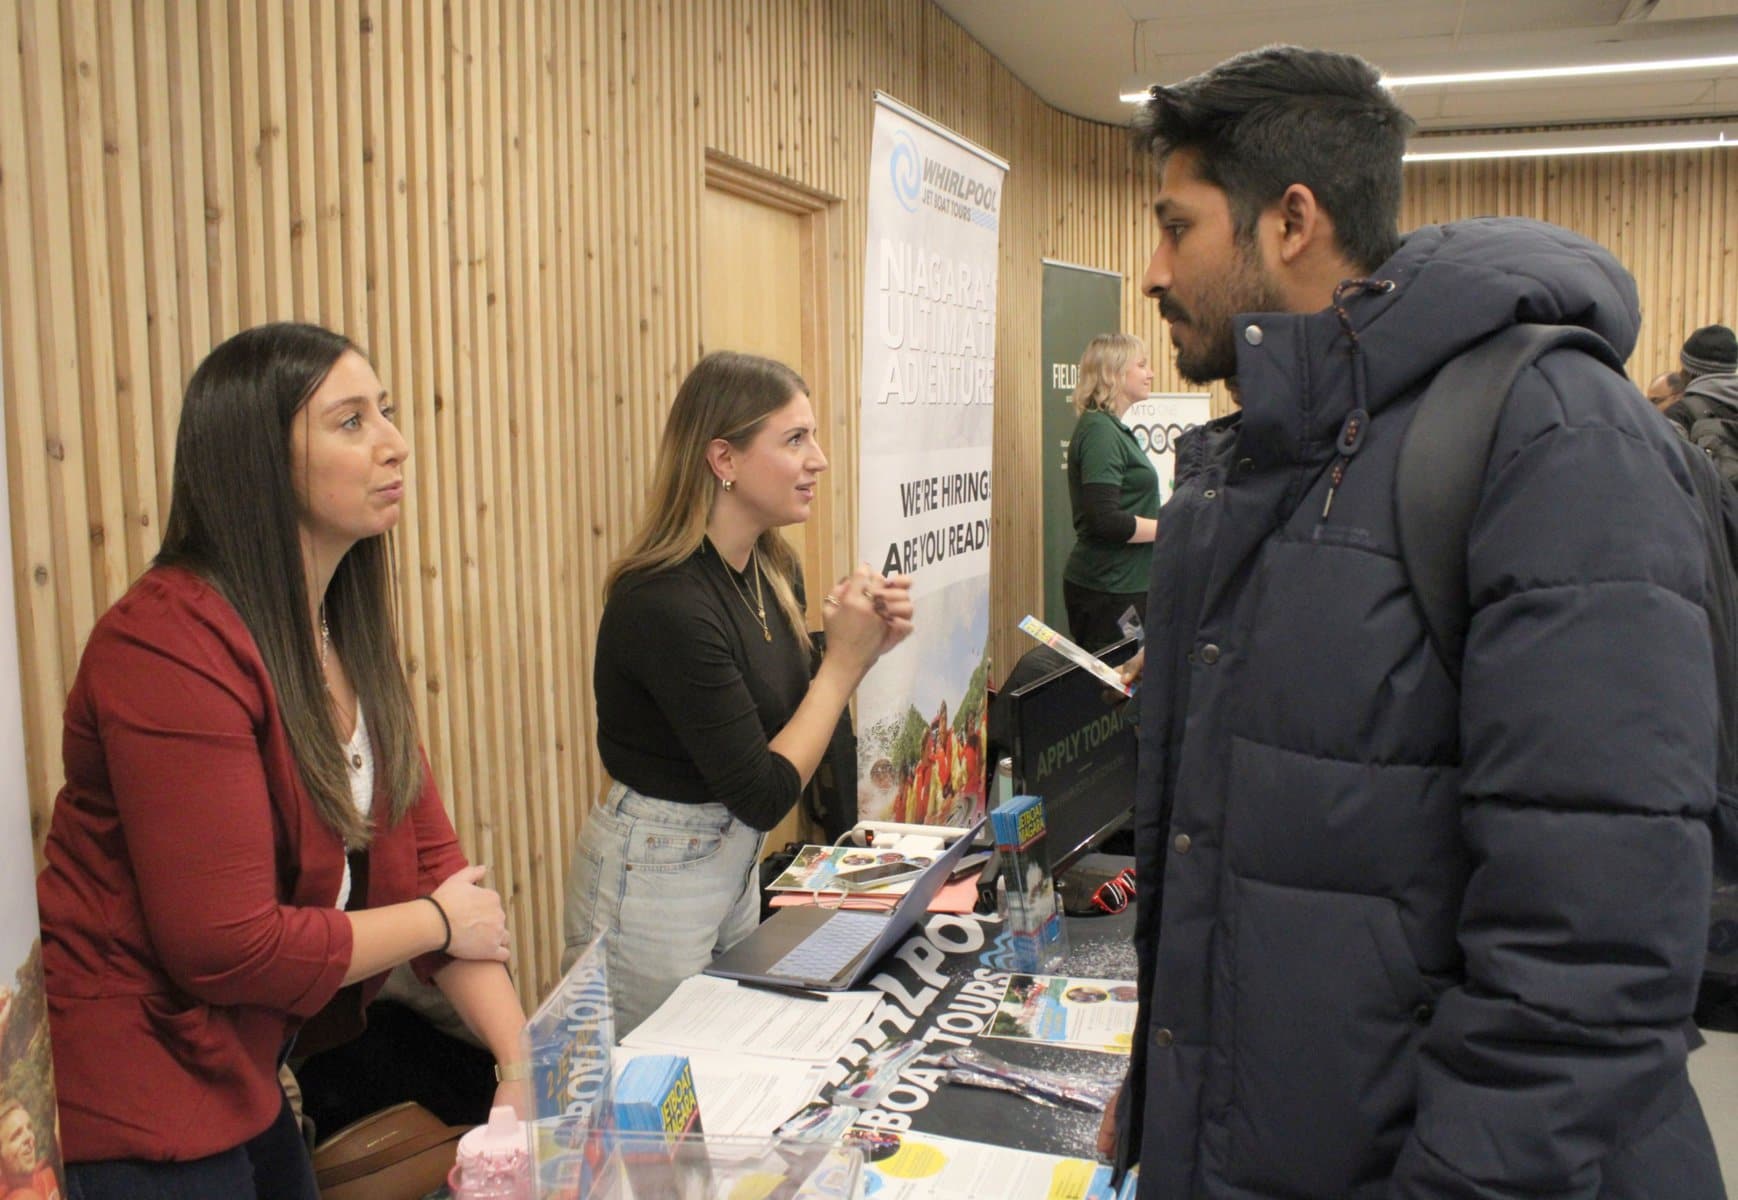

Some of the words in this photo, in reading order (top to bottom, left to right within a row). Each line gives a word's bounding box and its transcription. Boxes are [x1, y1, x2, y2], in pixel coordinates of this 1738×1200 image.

[923, 157, 997, 212] WHIRLPOOL
[951, 200, 971, 222] TOURS
[1052, 363, 1076, 390] FIELD
[900, 477, 938, 518] WE'RE
[882, 537, 918, 578] ARE
[919, 528, 945, 568] YOU
[1036, 730, 1081, 782] APPLY
[923, 967, 1013, 1047] TOURS
